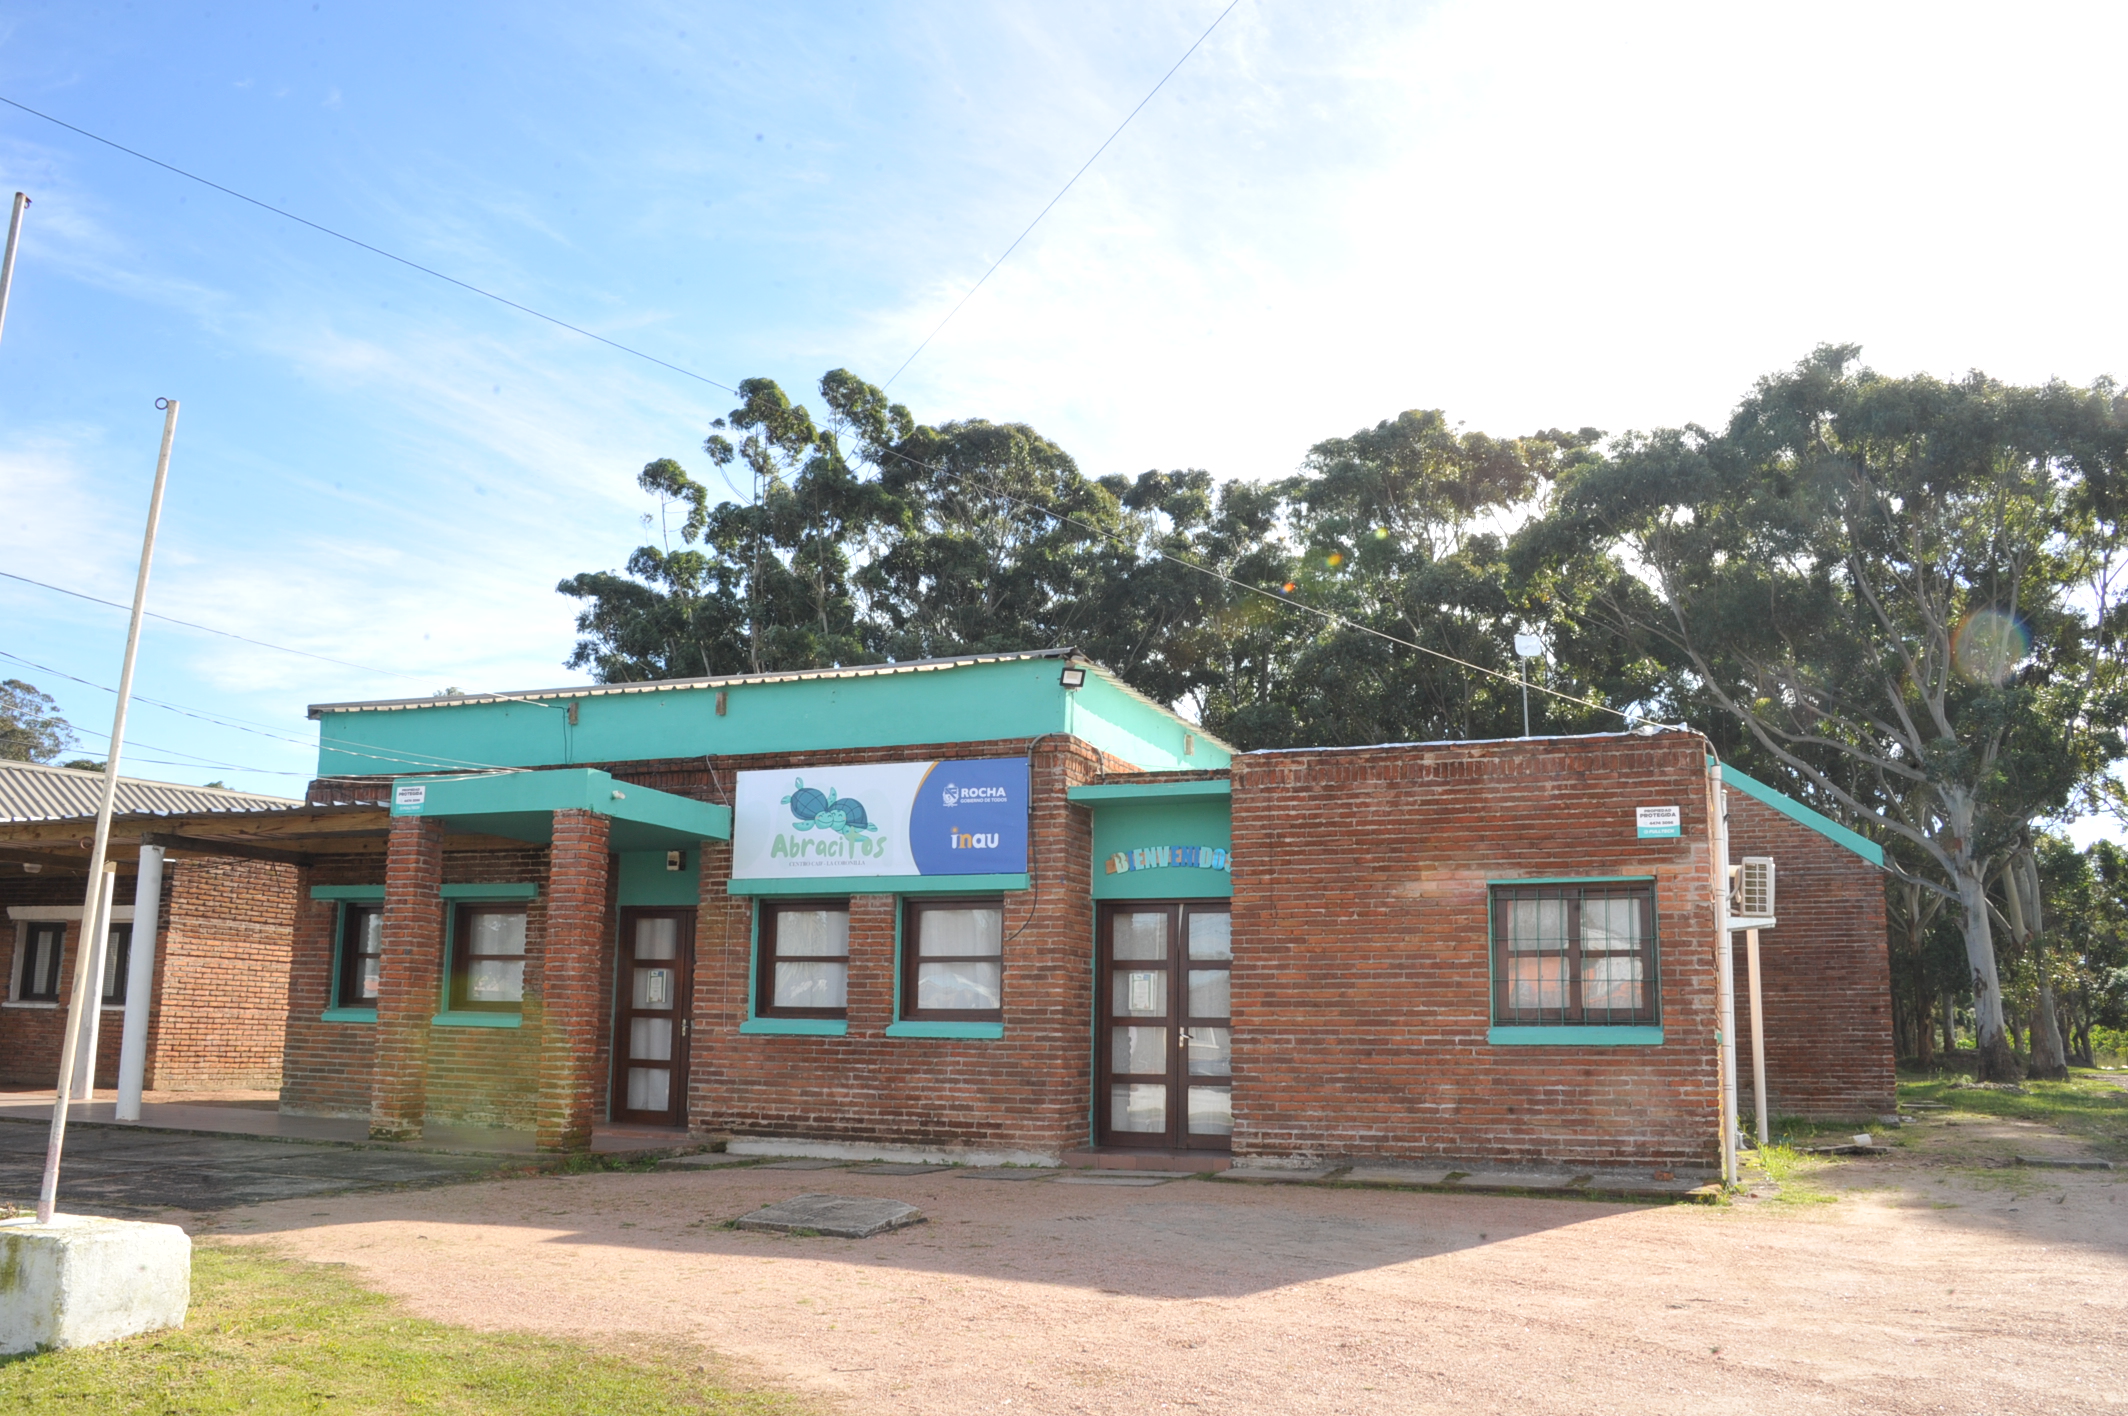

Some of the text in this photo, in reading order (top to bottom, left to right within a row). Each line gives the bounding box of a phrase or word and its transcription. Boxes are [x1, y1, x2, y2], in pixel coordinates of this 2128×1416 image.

[961, 787, 1006, 798] ROCHA
[770, 826, 887, 859] Abracitos
[950, 826, 999, 849] inau
